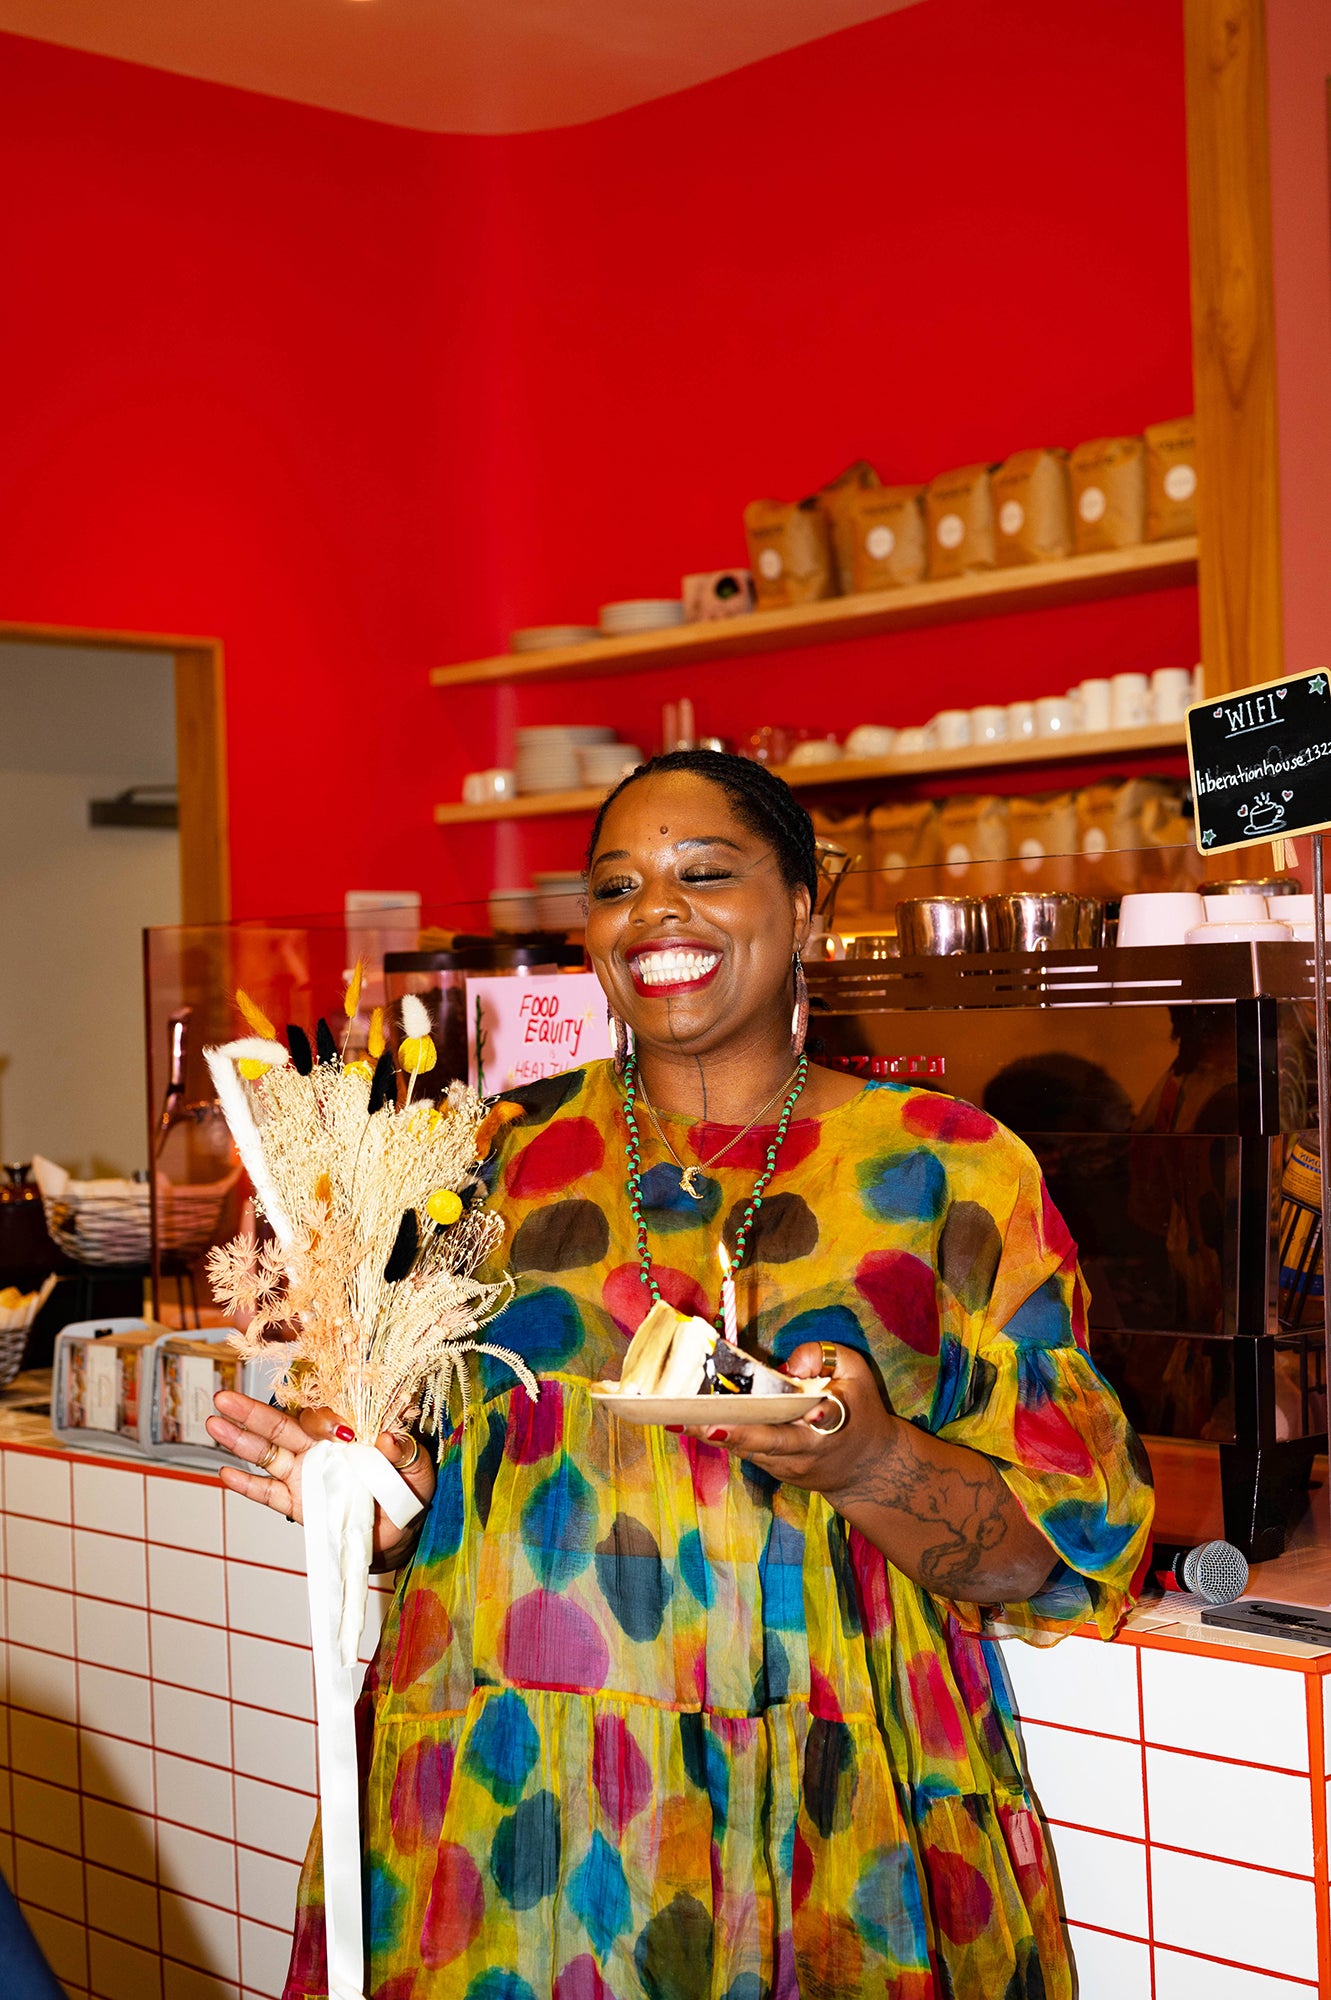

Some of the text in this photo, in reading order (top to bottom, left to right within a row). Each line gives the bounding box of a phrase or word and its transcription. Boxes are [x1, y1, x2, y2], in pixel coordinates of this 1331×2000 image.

[1224, 693, 1278, 732] WIFI
[519, 994, 559, 1018] FOOD
[524, 1018, 583, 1057] EQUITY
